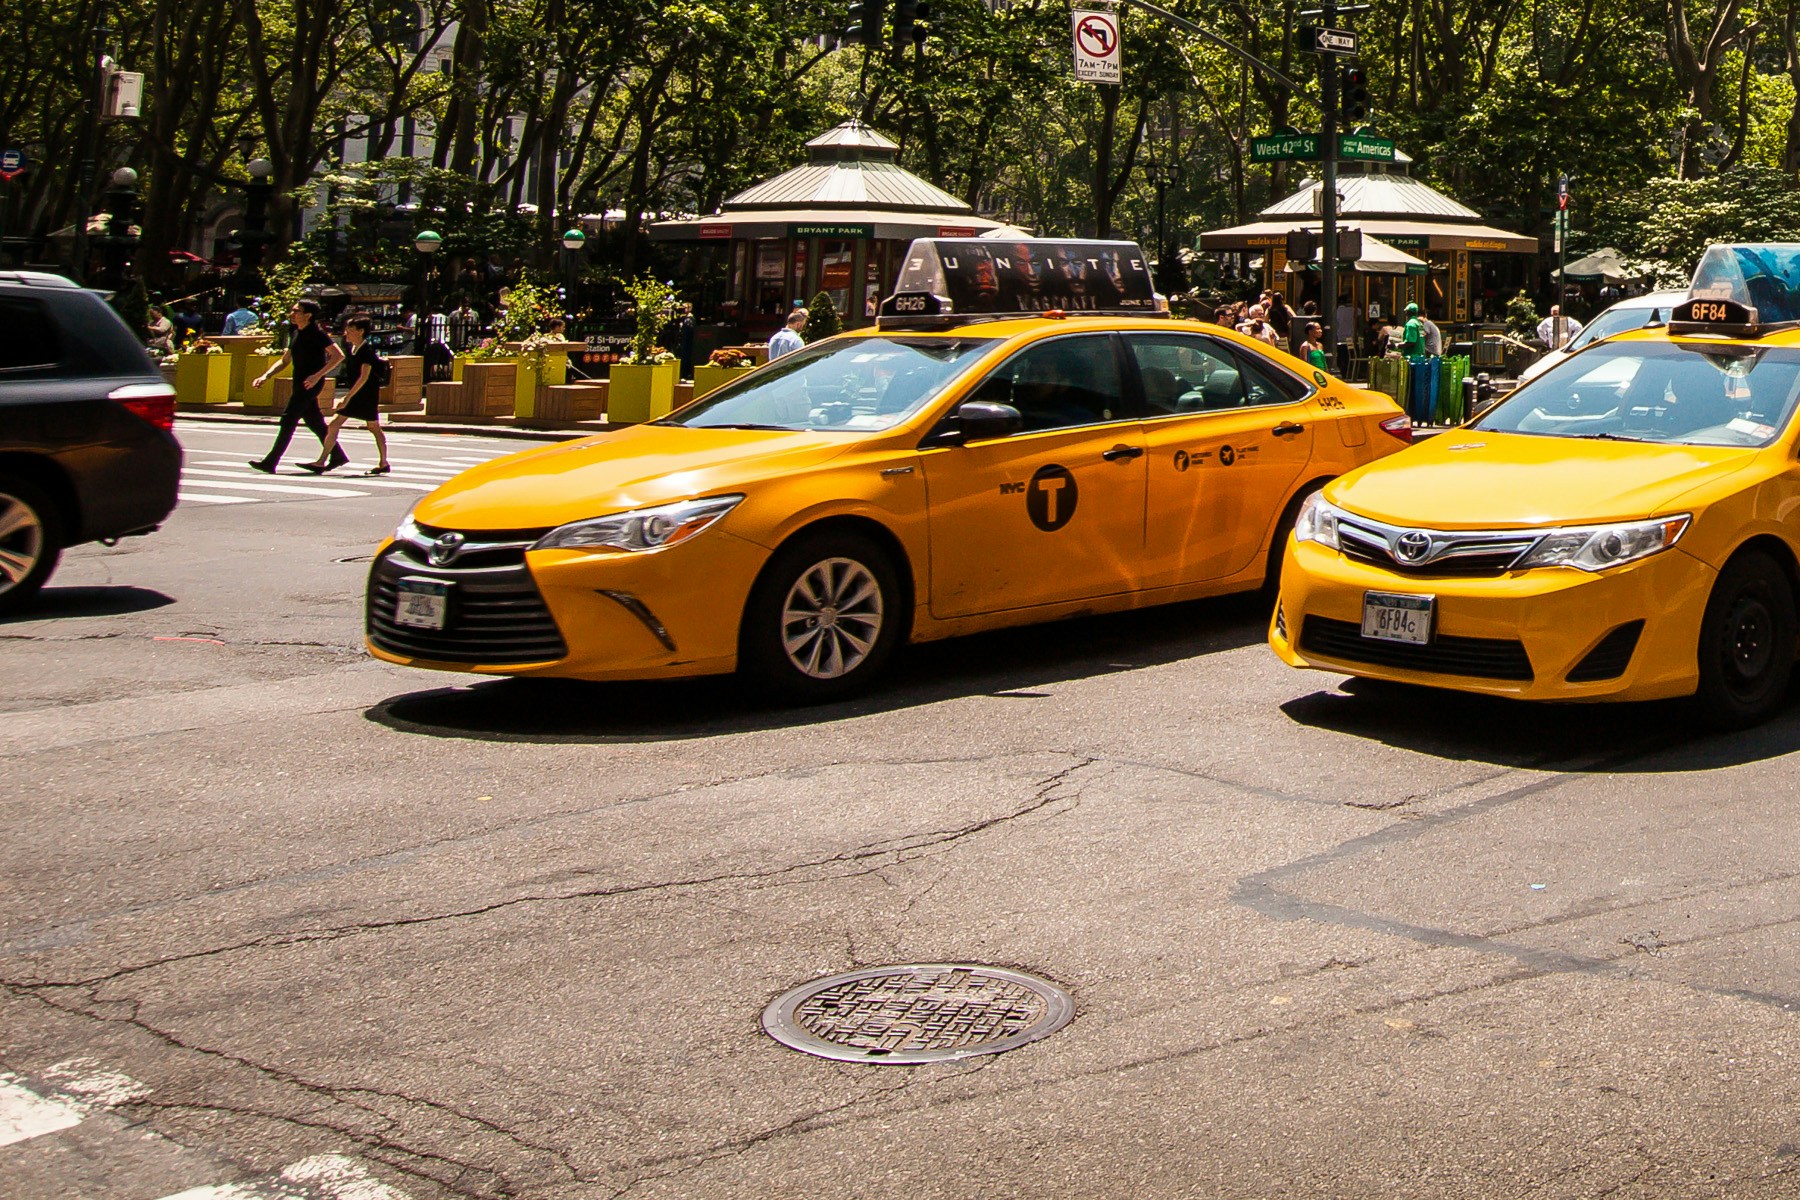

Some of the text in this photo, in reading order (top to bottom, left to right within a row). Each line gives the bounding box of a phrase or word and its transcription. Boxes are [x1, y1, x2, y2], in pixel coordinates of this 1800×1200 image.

[1321, 34, 1351, 46] ONE WAY
[1256, 140, 1314, 156] West 42nd St
[1357, 141, 1392, 157] Americas
[895, 296, 926, 311] 6H26
[1371, 305, 1379, 316] A
[1691, 303, 1727, 320] 6F84
[584, 336, 594, 344] 42
[584, 344, 610, 352] Station
[999, 481, 1026, 495] NYC
